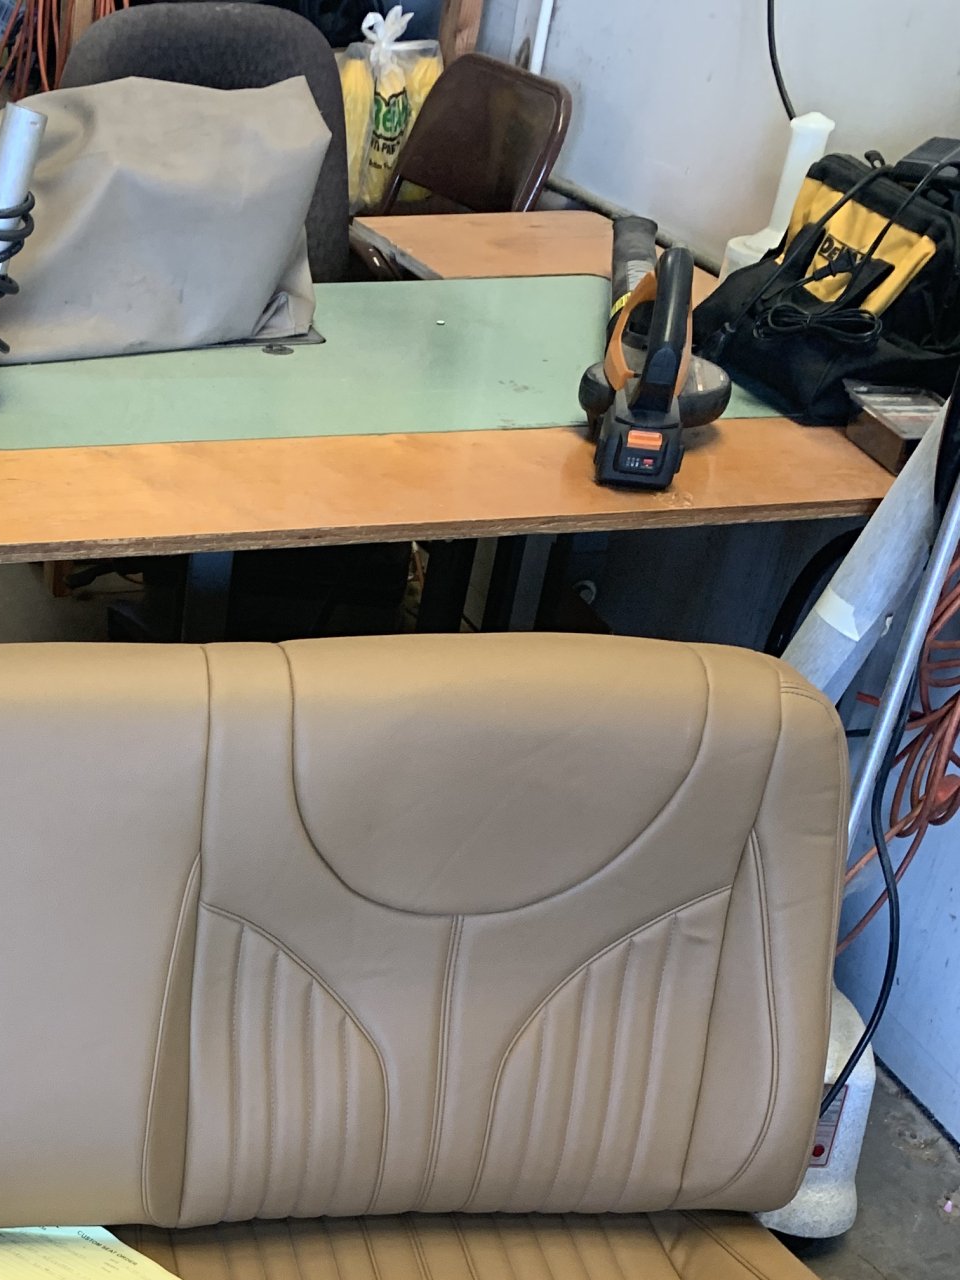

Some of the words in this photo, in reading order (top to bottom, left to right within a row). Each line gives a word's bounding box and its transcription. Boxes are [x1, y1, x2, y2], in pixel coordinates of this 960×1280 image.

[77, 1230, 102, 1246] CUSTOM
[101, 1245, 117, 1254] SEAT
[116, 1253, 138, 1265] ORDER
